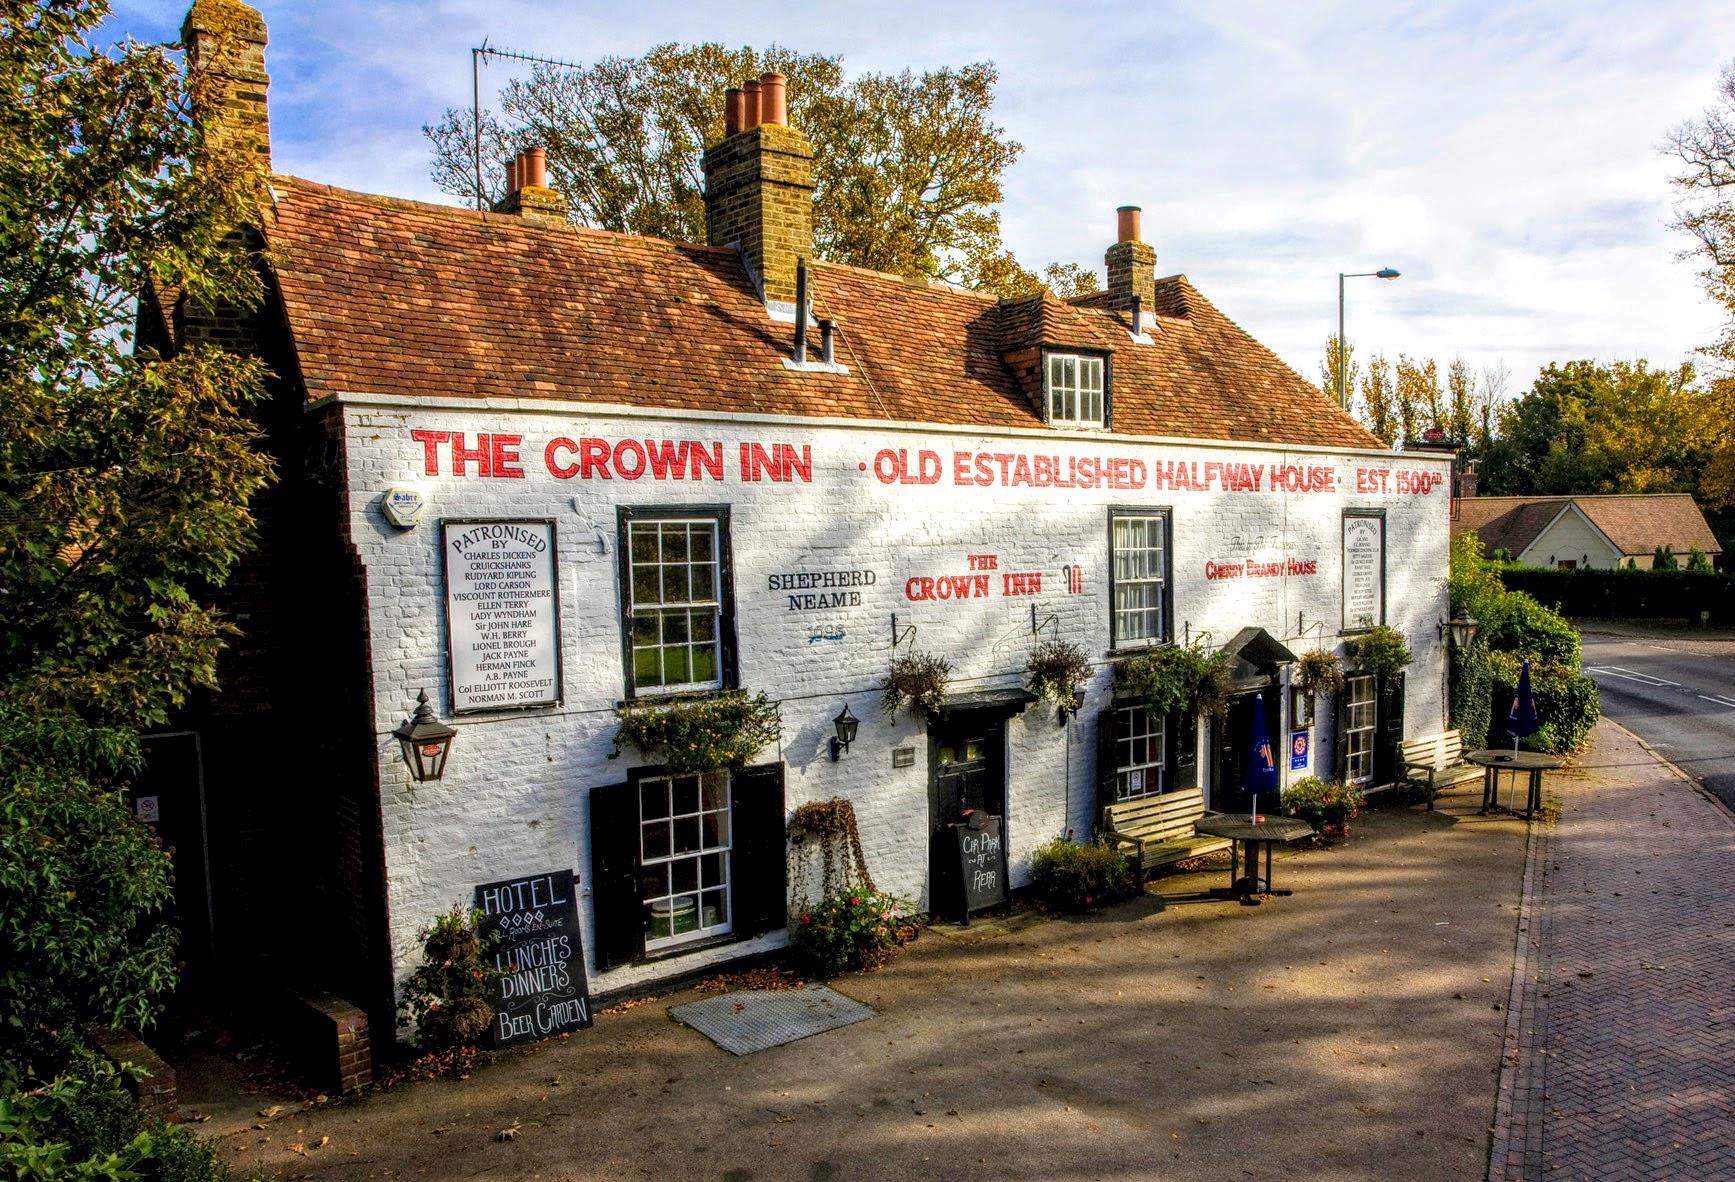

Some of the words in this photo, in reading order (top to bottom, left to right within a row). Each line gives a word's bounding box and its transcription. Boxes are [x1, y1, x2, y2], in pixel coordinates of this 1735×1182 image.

[411, 429, 525, 479] THE
[544, 437, 724, 481] CROWN
[740, 442, 812, 482] INN
[874, 448, 942, 485] OLD
[953, 451, 1147, 490] ESTABLISHED
[1156, 460, 1264, 492] HALFWAY
[1270, 463, 1335, 494] HOUSE
[1356, 468, 1391, 494] EST.
[452, 525, 547, 554] PATRONISED
[492, 540, 508, 549] BY
[464, 552, 500, 560] CHARLES
[502, 551, 536, 560] DICKENS
[967, 554, 998, 571] THE
[470, 561, 531, 570] CRUICKSHANKS
[1205, 561, 1244, 580] CHERRY
[1246, 559, 1285, 577] BRANDY
[1287, 557, 1317, 576] HOUSE
[465, 572, 504, 580] RUDYARD
[506, 571, 537, 580] KIPLING
[768, 570, 876, 590] SHEPHERD
[474, 582, 497, 591] LORD
[498, 581, 531, 590] CARSON
[905, 574, 990, 601] CROWN
[1002, 572, 1042, 597] INN
[453, 592, 496, 601] VISCOUNT
[498, 590, 551, 599] ROTHERMERE
[788, 591, 861, 611] NEAME
[477, 601, 502, 610] ELLEN
[504, 600, 529, 609] TERRY
[470, 612, 492, 620] LADY
[494, 610, 537, 619] WYNDHAM
[475, 622, 486, 631] Sir
[487, 621, 509, 631] JOHN
[511, 620, 532, 629] HARE
[481, 632, 500, 640] W.H.
[503, 630, 527, 639] BERRY
[472, 642, 502, 650] LIONEL
[503, 640, 537, 649] BROUGH
[482, 652, 502, 662] JACK
[503, 650, 528, 659] PAYNE
[476, 662, 511, 671] HERMAN
[513, 660, 536, 669] FINCK
[485, 672, 501, 681] A.B.
[503, 670, 528, 679] PAYNE
[458, 685, 472, 694] Col
[474, 682, 507, 692] ELLIOTT
[508, 679, 553, 690] ROOSEVELT
[468, 693, 505, 704] NORMAN
[507, 692, 517, 701] M.
[519, 690, 545, 699] SCOTT
[963, 836, 980, 855] CAR
[981, 832, 1001, 854] PARK
[976, 854, 987, 868] AT
[973, 870, 996, 892] REAR
[483, 876, 567, 915] HOTEL
[508, 925, 531, 942] ROOMS
[496, 935, 572, 974] LUNCHES
[501, 961, 570, 998] DINNERS
[498, 1012, 537, 1040] BEER
[536, 997, 588, 1034] GARDEN
